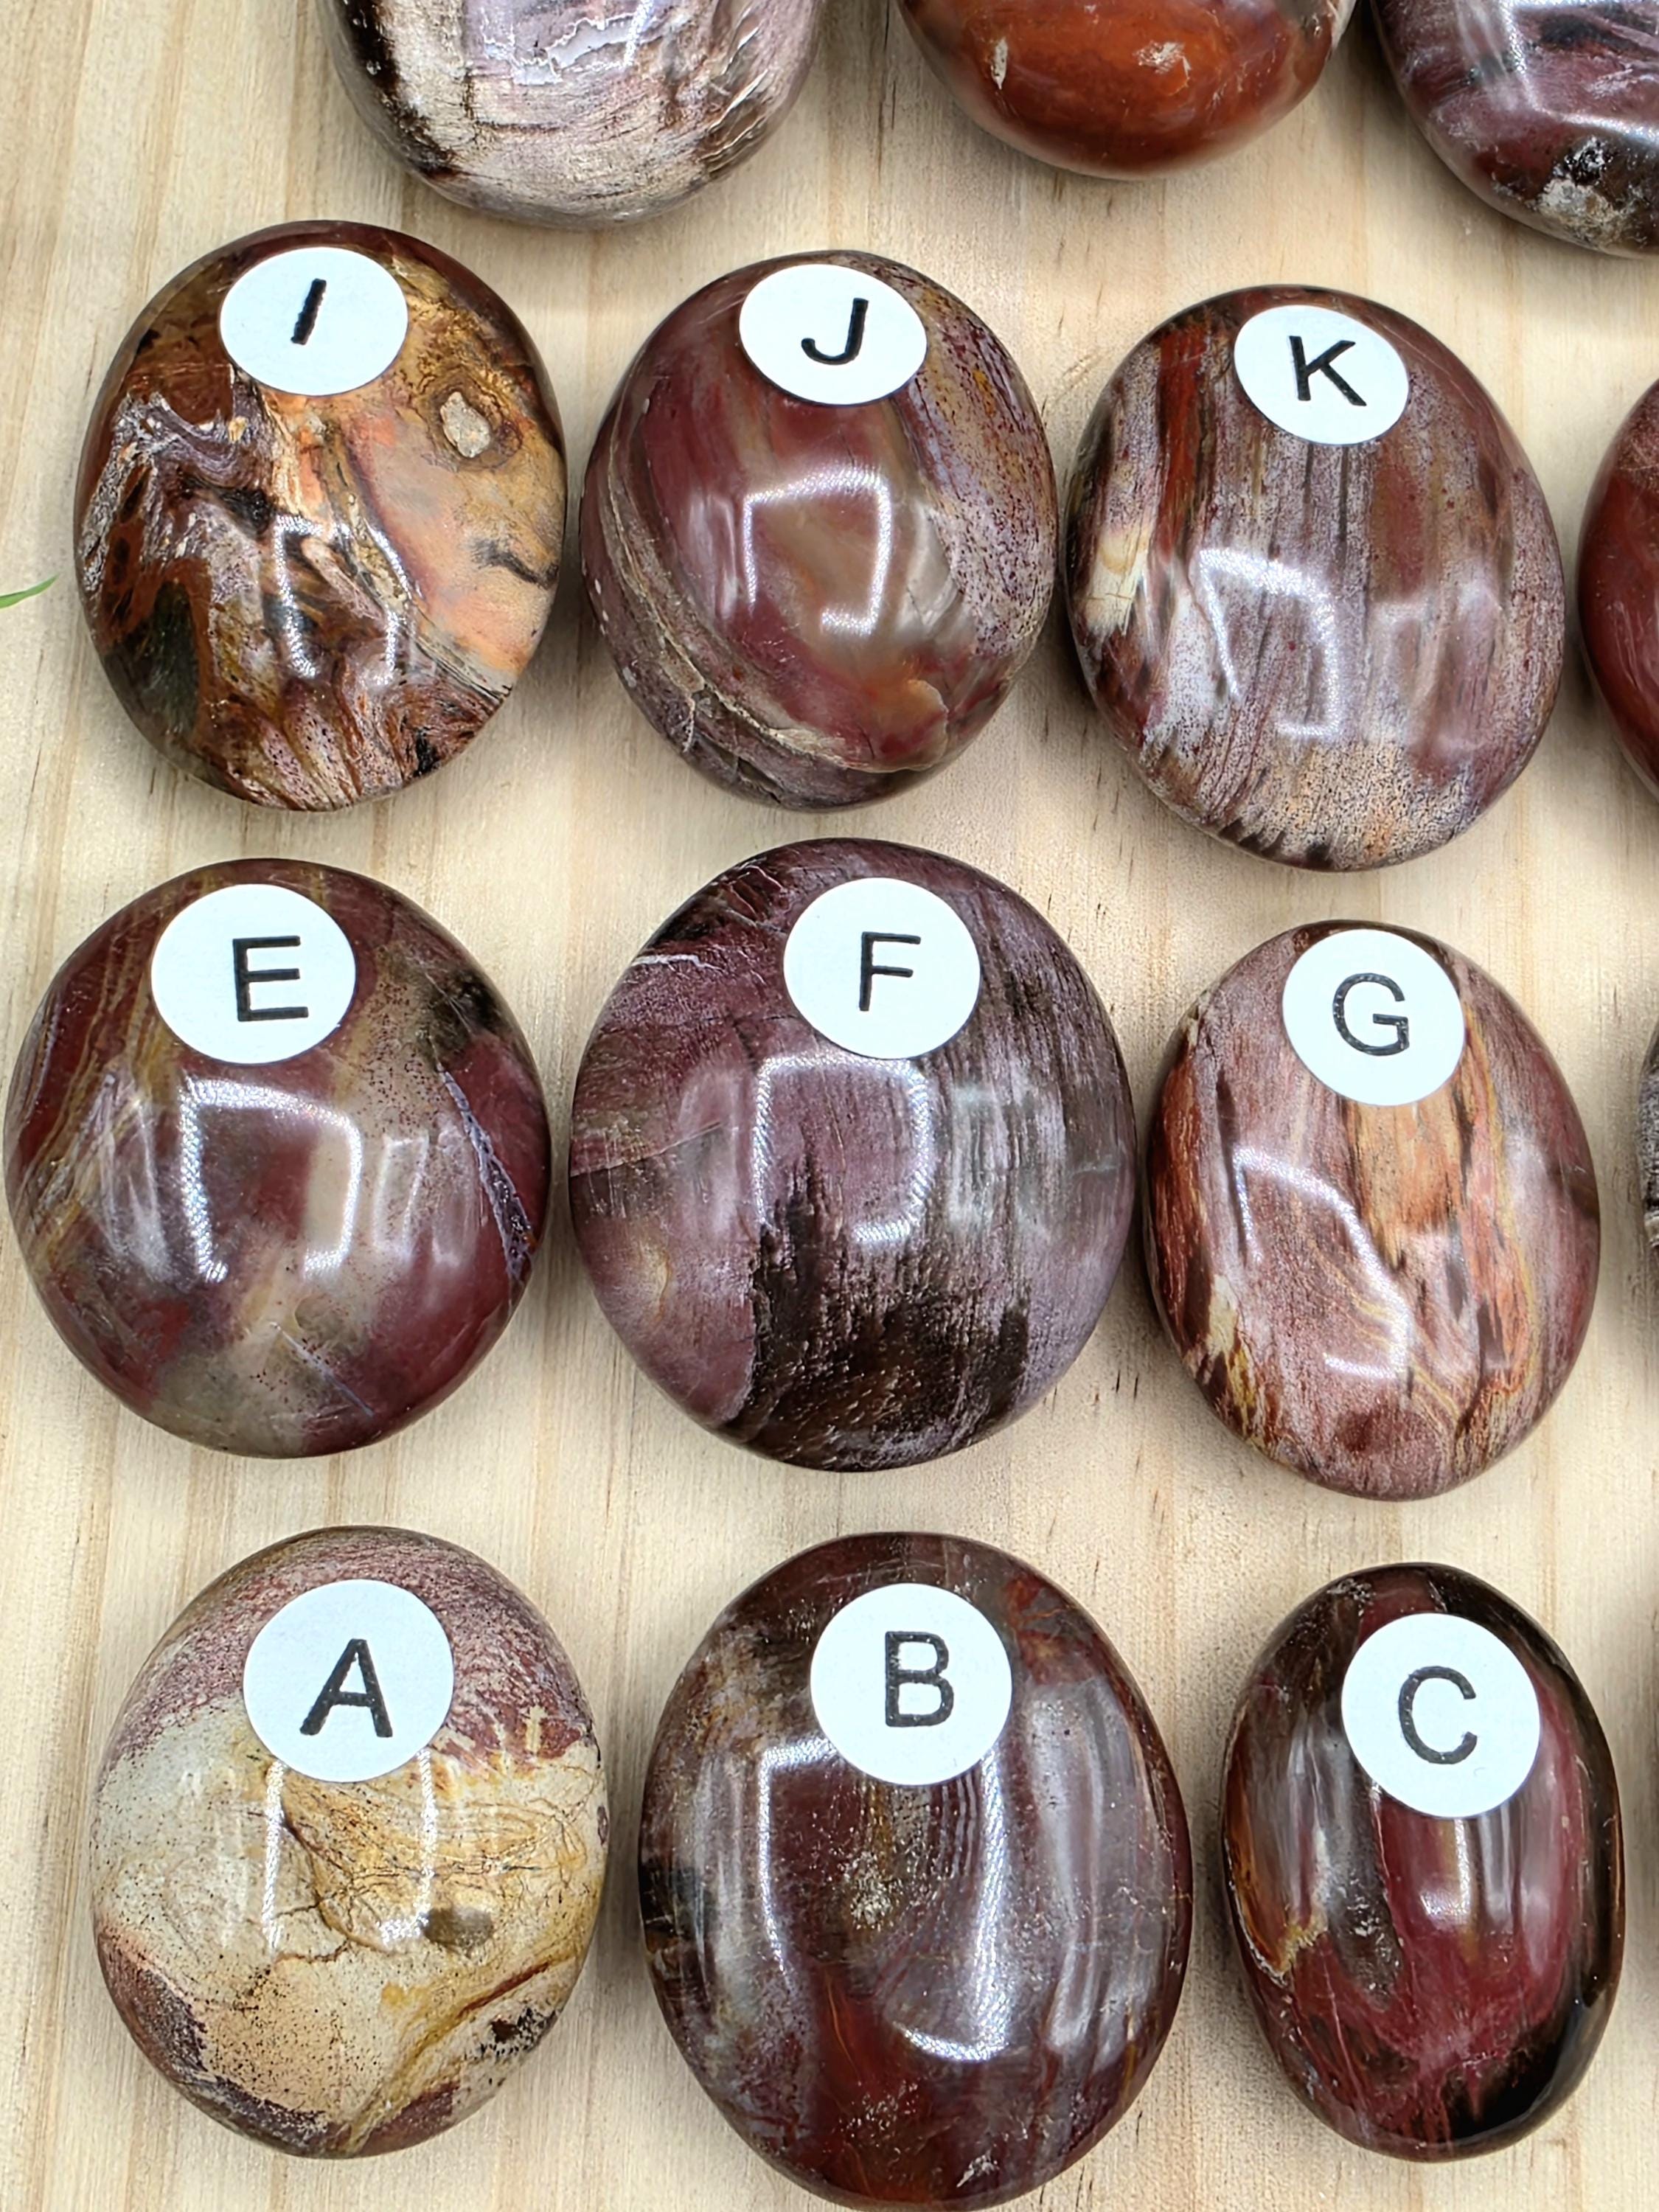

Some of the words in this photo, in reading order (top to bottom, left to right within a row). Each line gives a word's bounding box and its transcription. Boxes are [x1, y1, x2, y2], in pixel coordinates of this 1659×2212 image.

[291, 279, 327, 345] I
[801, 298, 869, 365] J
[1290, 335, 1366, 406] K
[232, 936, 308, 1022] E
[859, 932, 921, 1011] F
[1333, 973, 1409, 1056] G
[300, 1639, 392, 1737] A
[886, 1632, 953, 1727] B
[1398, 1666, 1477, 1764] C
